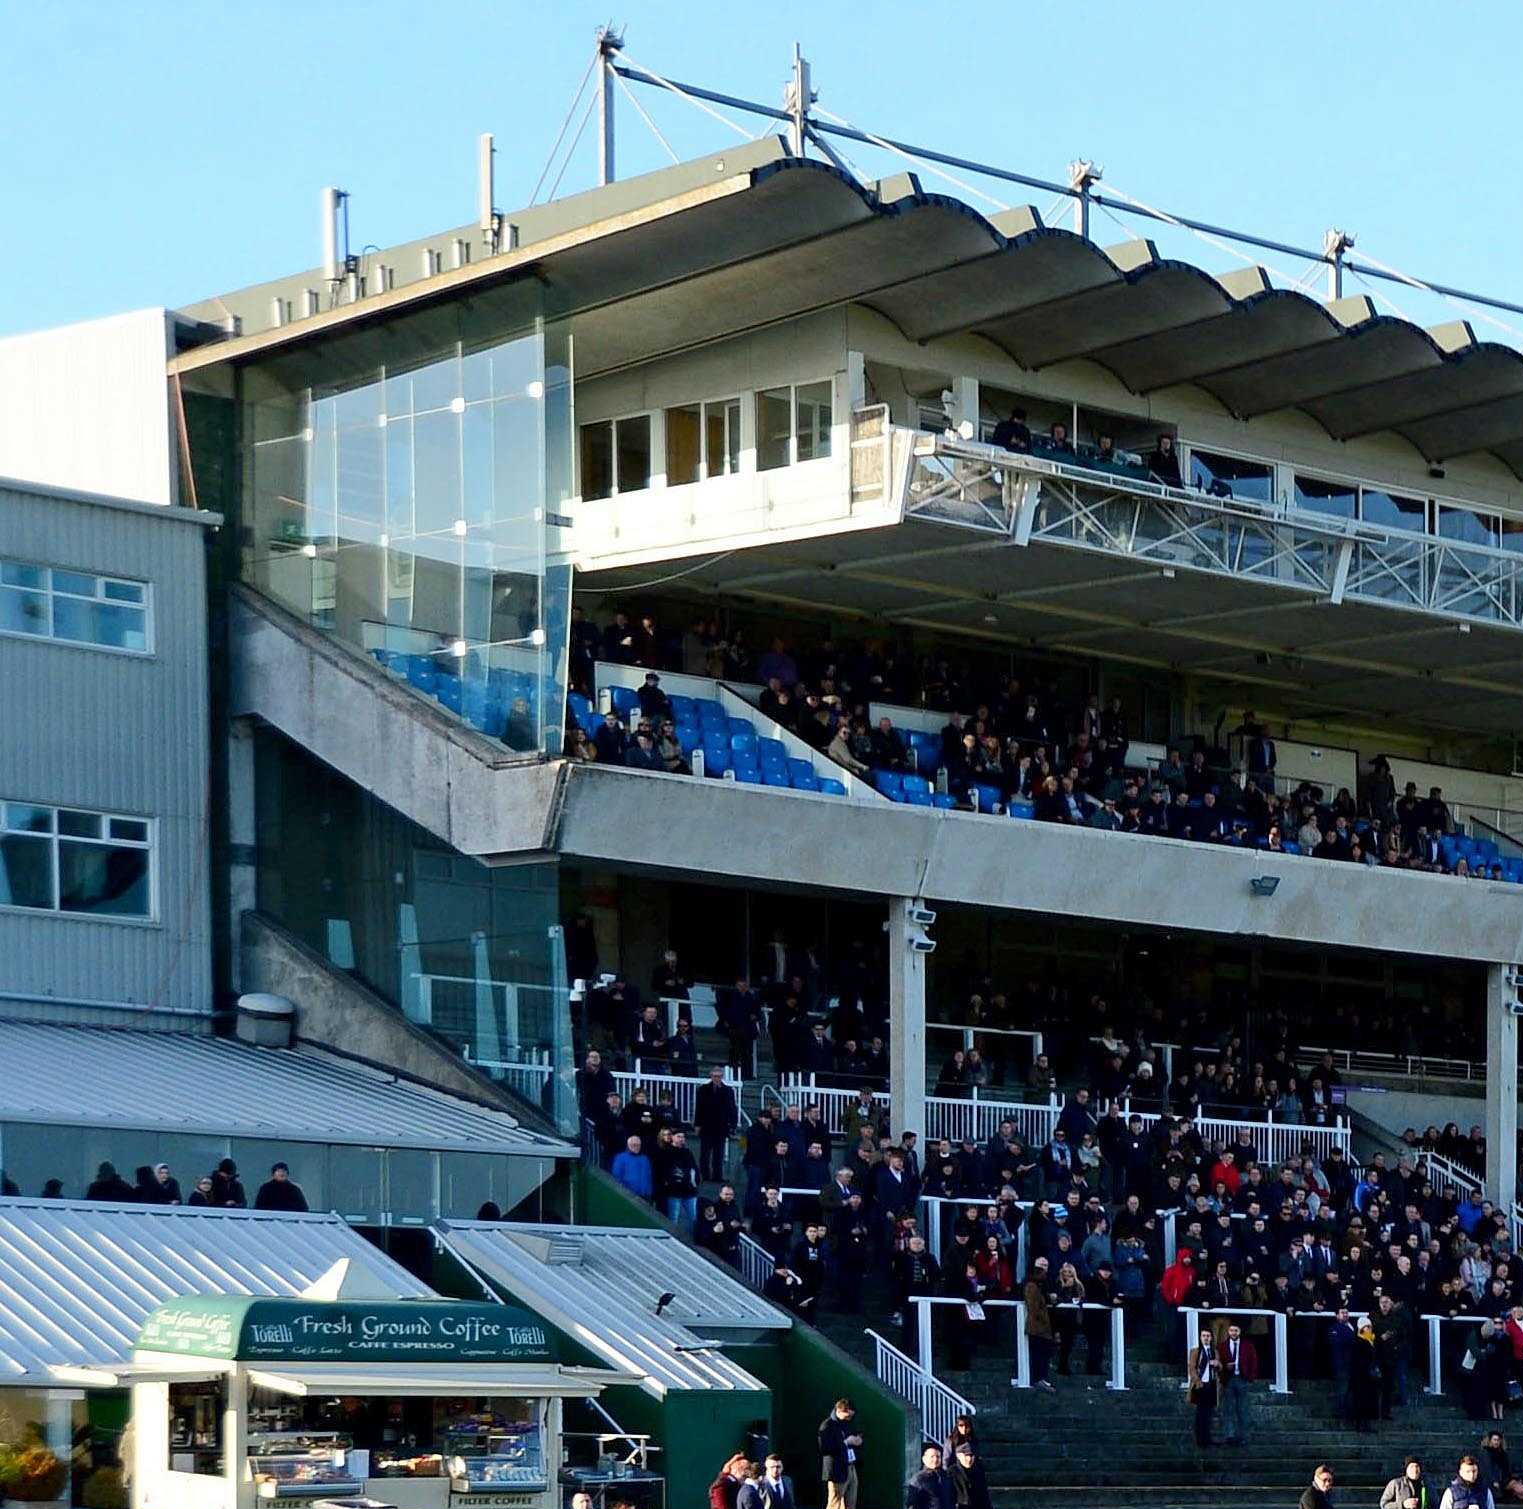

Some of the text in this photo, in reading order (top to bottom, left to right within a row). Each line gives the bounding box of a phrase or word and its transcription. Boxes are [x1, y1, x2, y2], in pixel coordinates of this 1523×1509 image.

[293, 1315, 501, 1342] Fresh Ground Coffee
[393, 1341, 456, 1350] ESPRESSO
